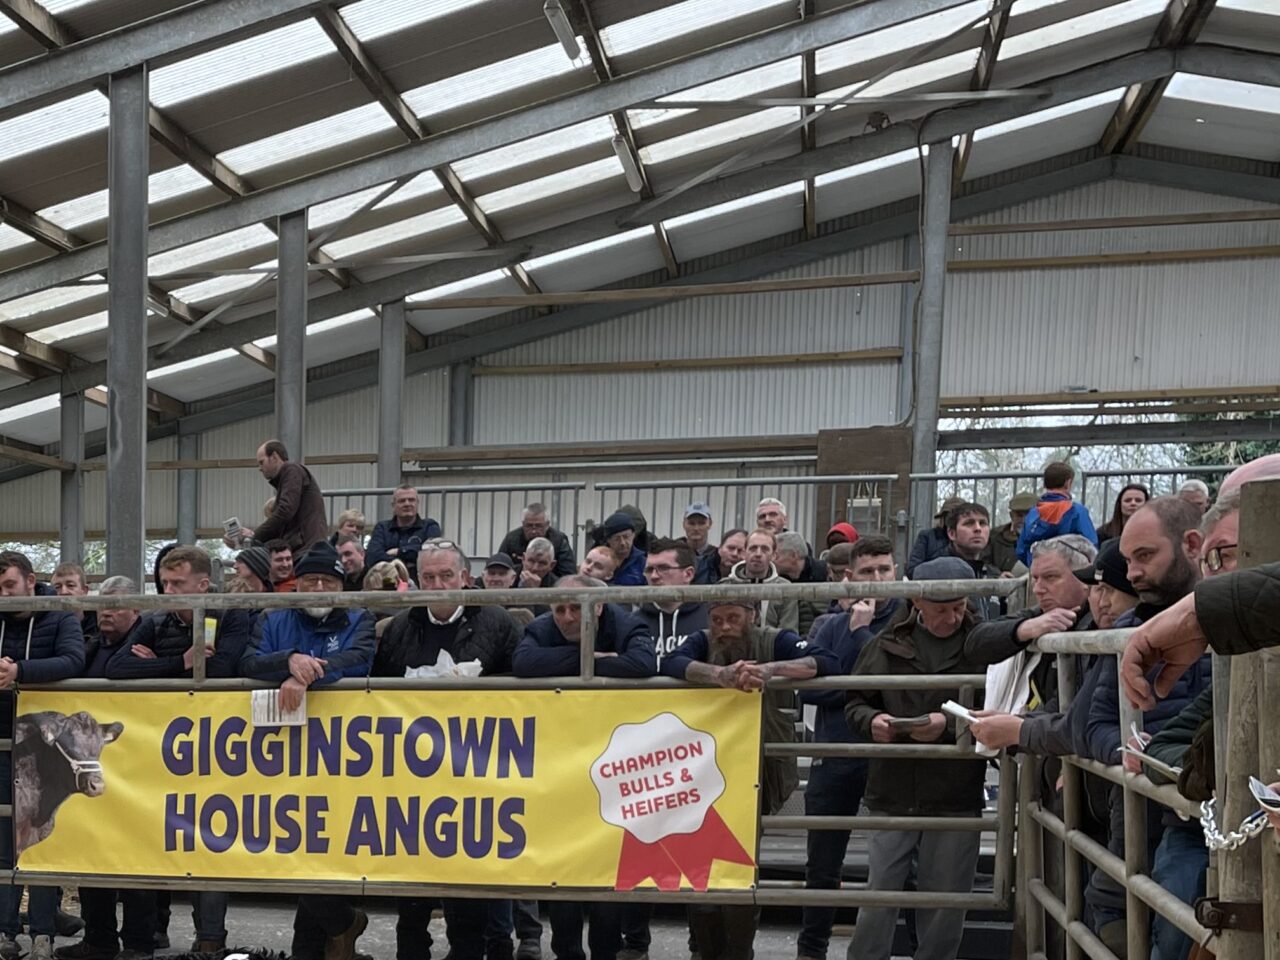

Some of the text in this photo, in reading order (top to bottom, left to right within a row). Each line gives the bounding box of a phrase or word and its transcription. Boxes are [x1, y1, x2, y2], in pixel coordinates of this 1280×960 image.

[162, 716, 536, 779] GIGGINSTOWN
[599, 741, 704, 779] CHAMPION
[619, 767, 694, 798] BULLS &
[621, 788, 701, 820] HEIFERS
[164, 793, 527, 860] HOUSE ANGUS
